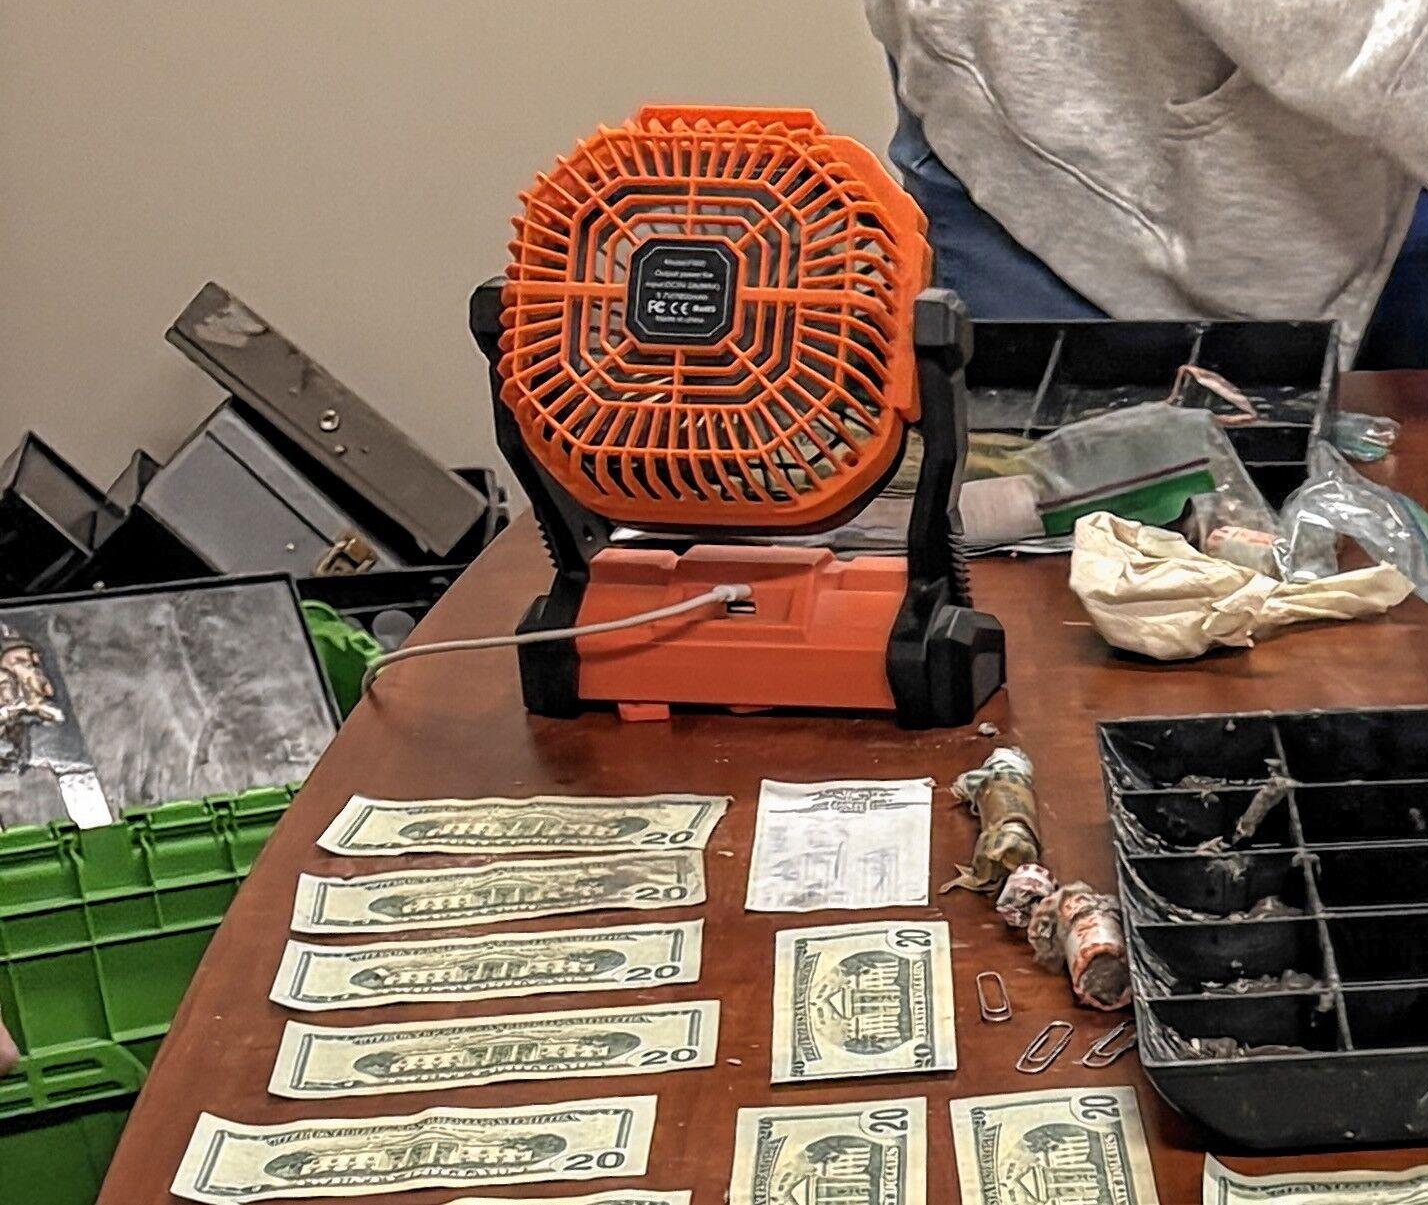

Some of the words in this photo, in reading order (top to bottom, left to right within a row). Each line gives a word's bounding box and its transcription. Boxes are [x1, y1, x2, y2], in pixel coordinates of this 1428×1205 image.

[641, 830, 695, 845] 20
[634, 886, 688, 902] 20
[894, 928, 932, 948] 20
[625, 964, 681, 982] 20
[640, 1047, 698, 1067] 20
[1078, 1094, 1121, 1121] 20
[868, 1107, 909, 1134] 20
[562, 1151, 626, 1171] 20
